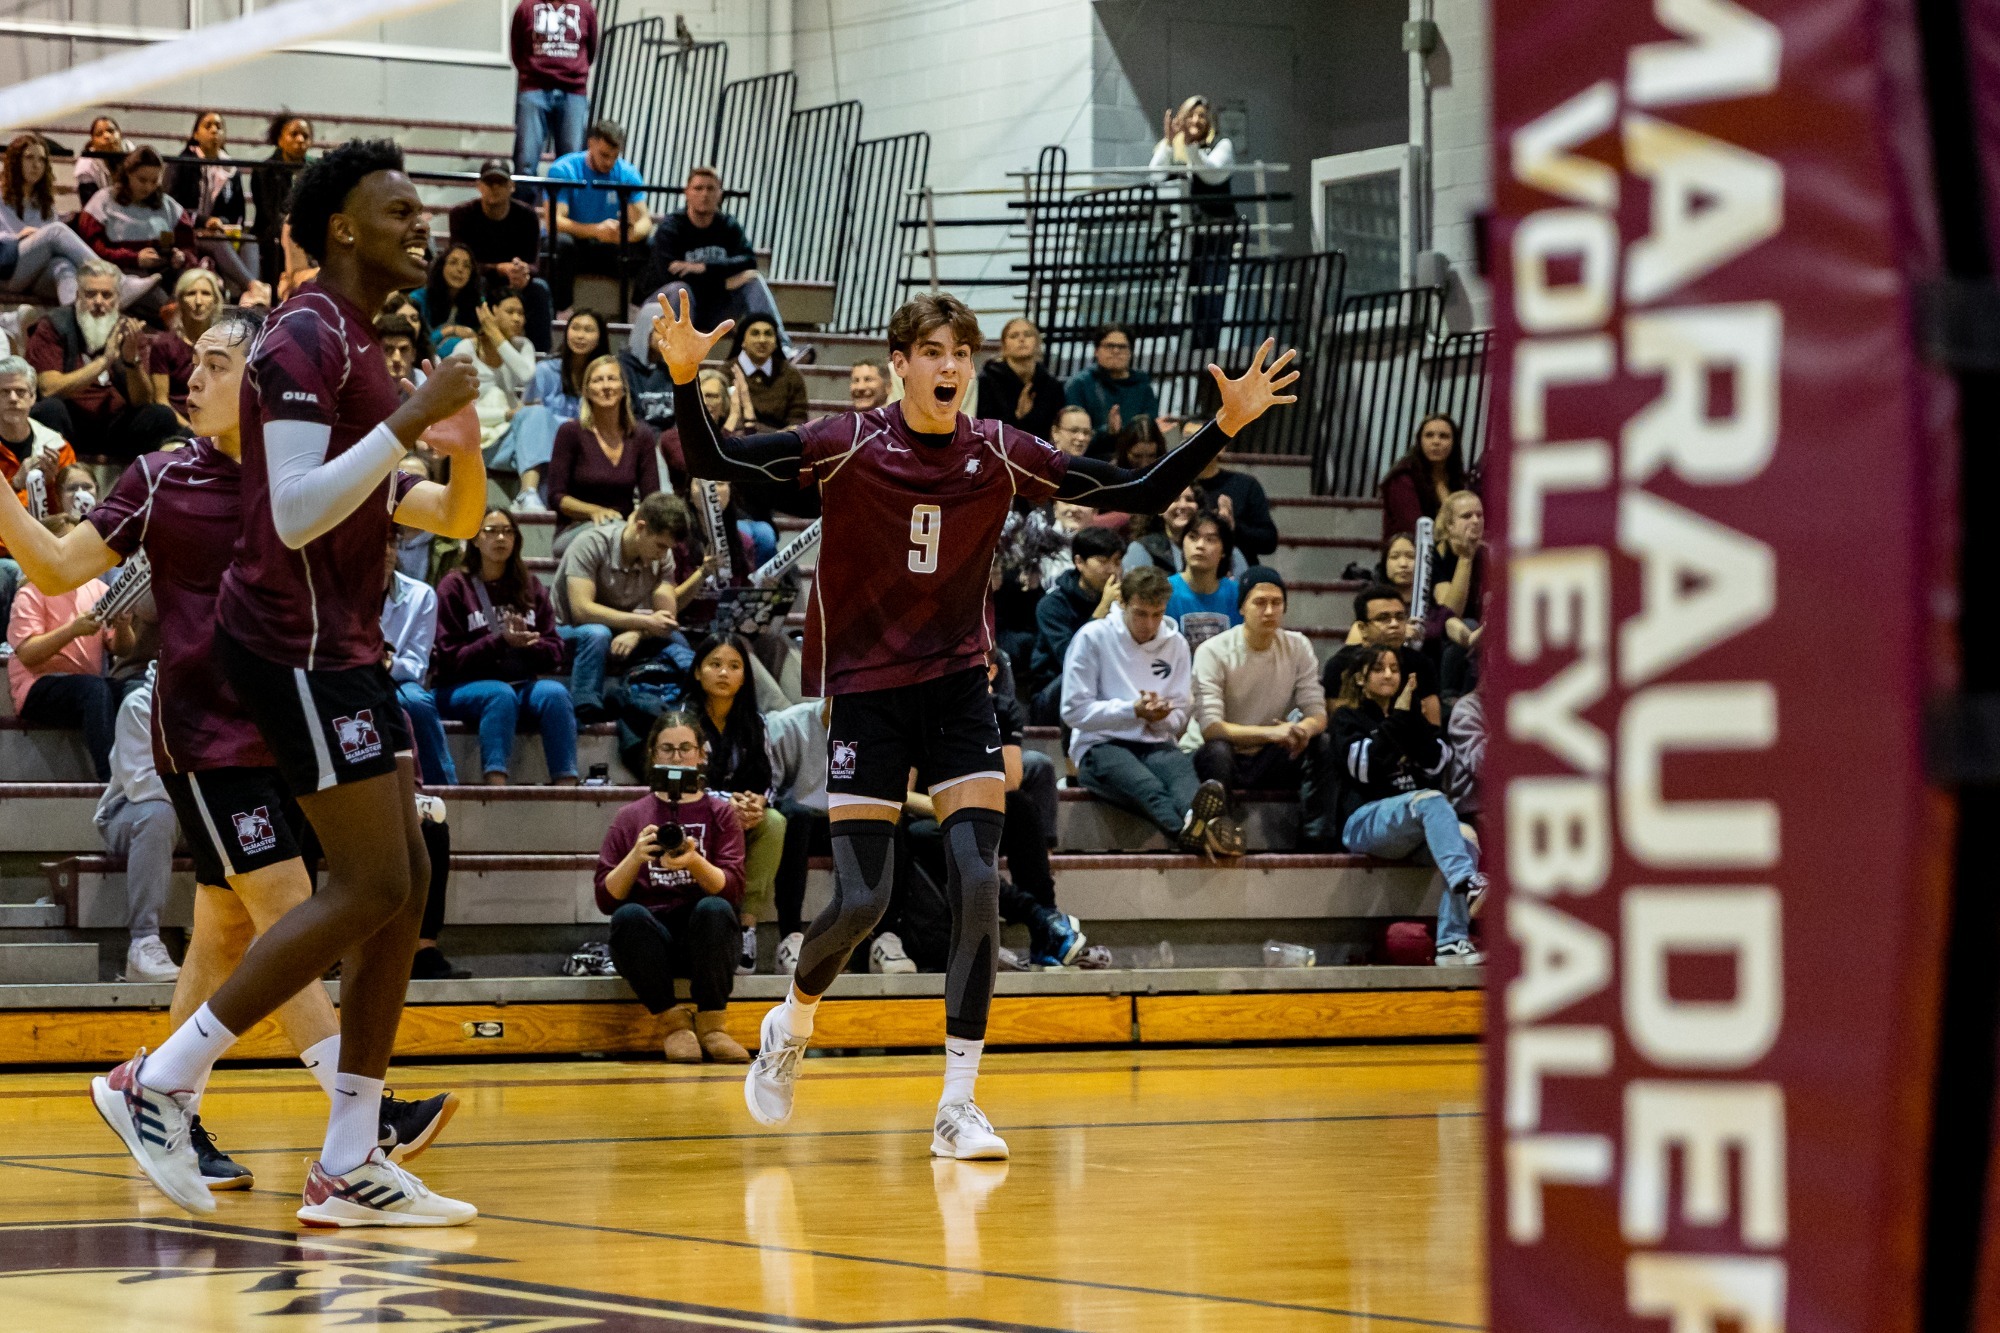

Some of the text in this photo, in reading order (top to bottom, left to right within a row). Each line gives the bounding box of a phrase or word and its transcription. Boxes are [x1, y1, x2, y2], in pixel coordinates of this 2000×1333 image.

[282, 391, 318, 403] OUA
[908, 504, 941, 573] 9
[1507, 82, 1616, 1245] VOLLEYBALL
[345, 743, 382, 760] McMASTER
[242, 837, 276, 851] McMASTER
